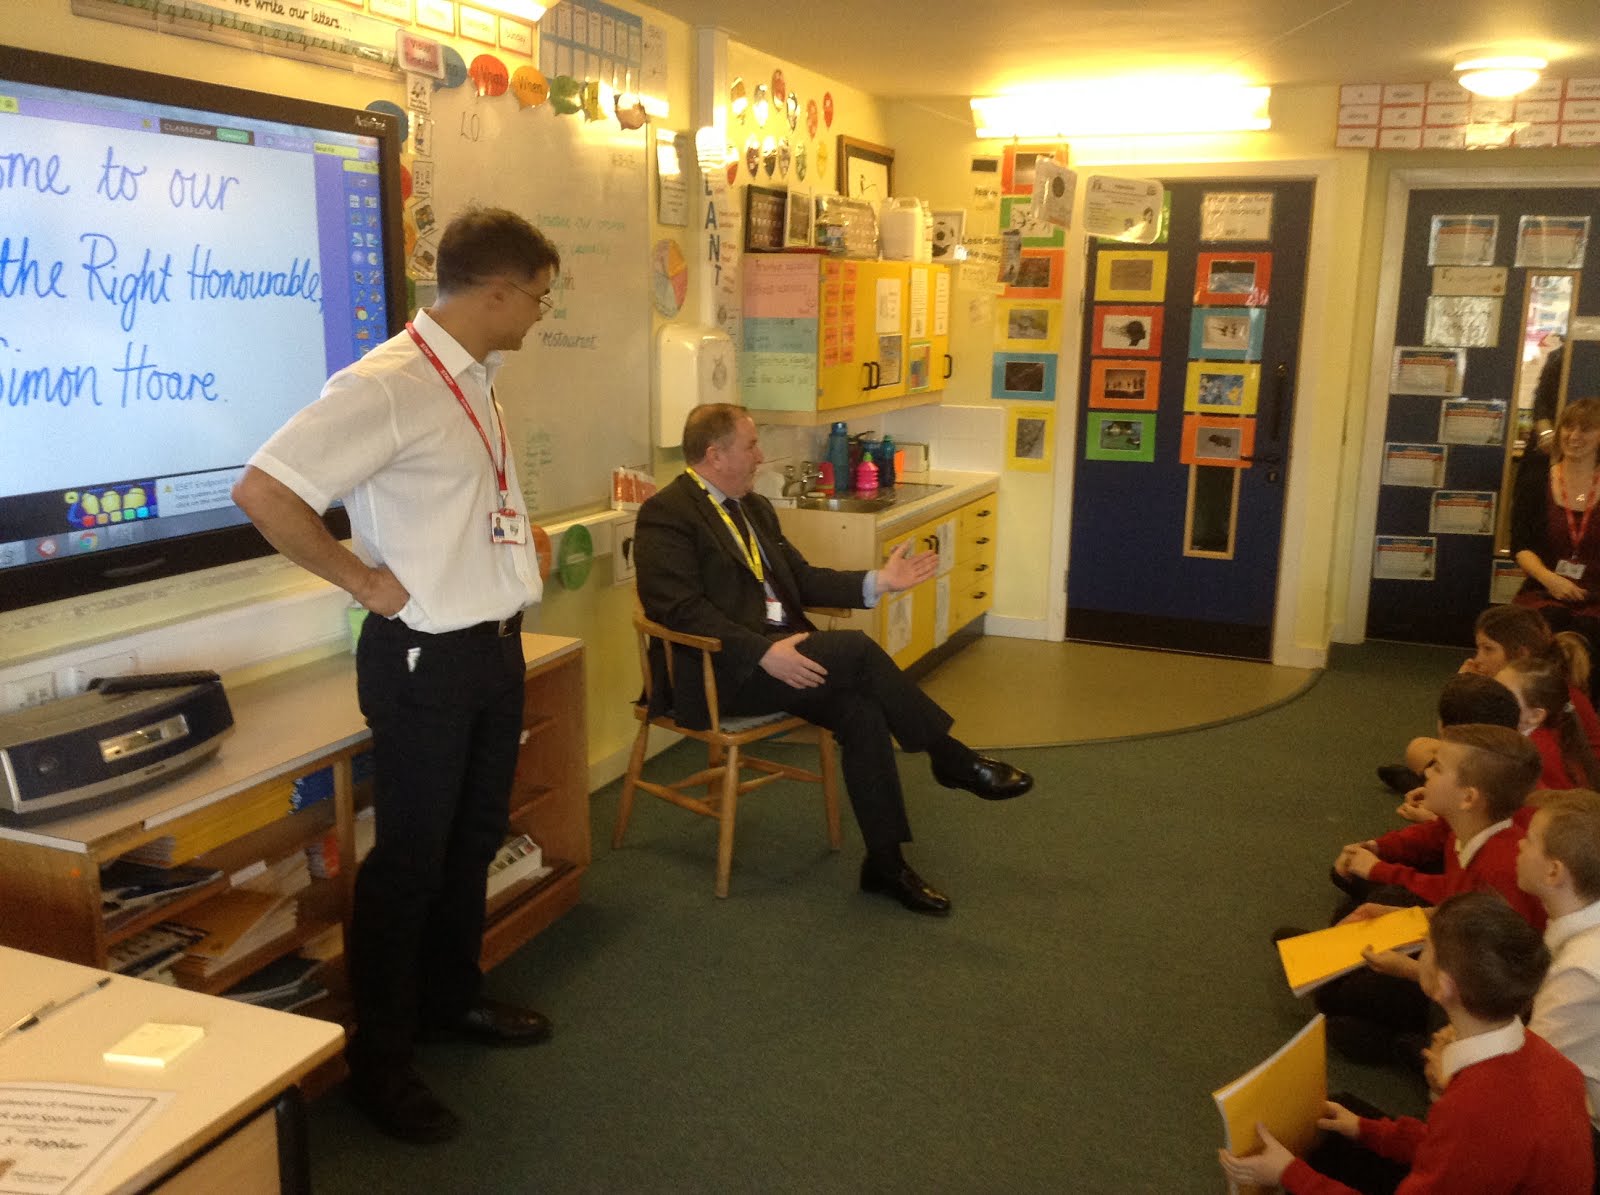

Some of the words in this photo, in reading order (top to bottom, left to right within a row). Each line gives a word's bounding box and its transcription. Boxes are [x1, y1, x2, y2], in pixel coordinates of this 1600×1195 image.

[255, 0, 285, 16] write
[288, 7, 309, 20] our
[97, 146, 148, 201] to
[169, 168, 240, 211] our
[0, 237, 66, 298] the
[79, 232, 172, 332] Right
[0, 340, 103, 407] imon
